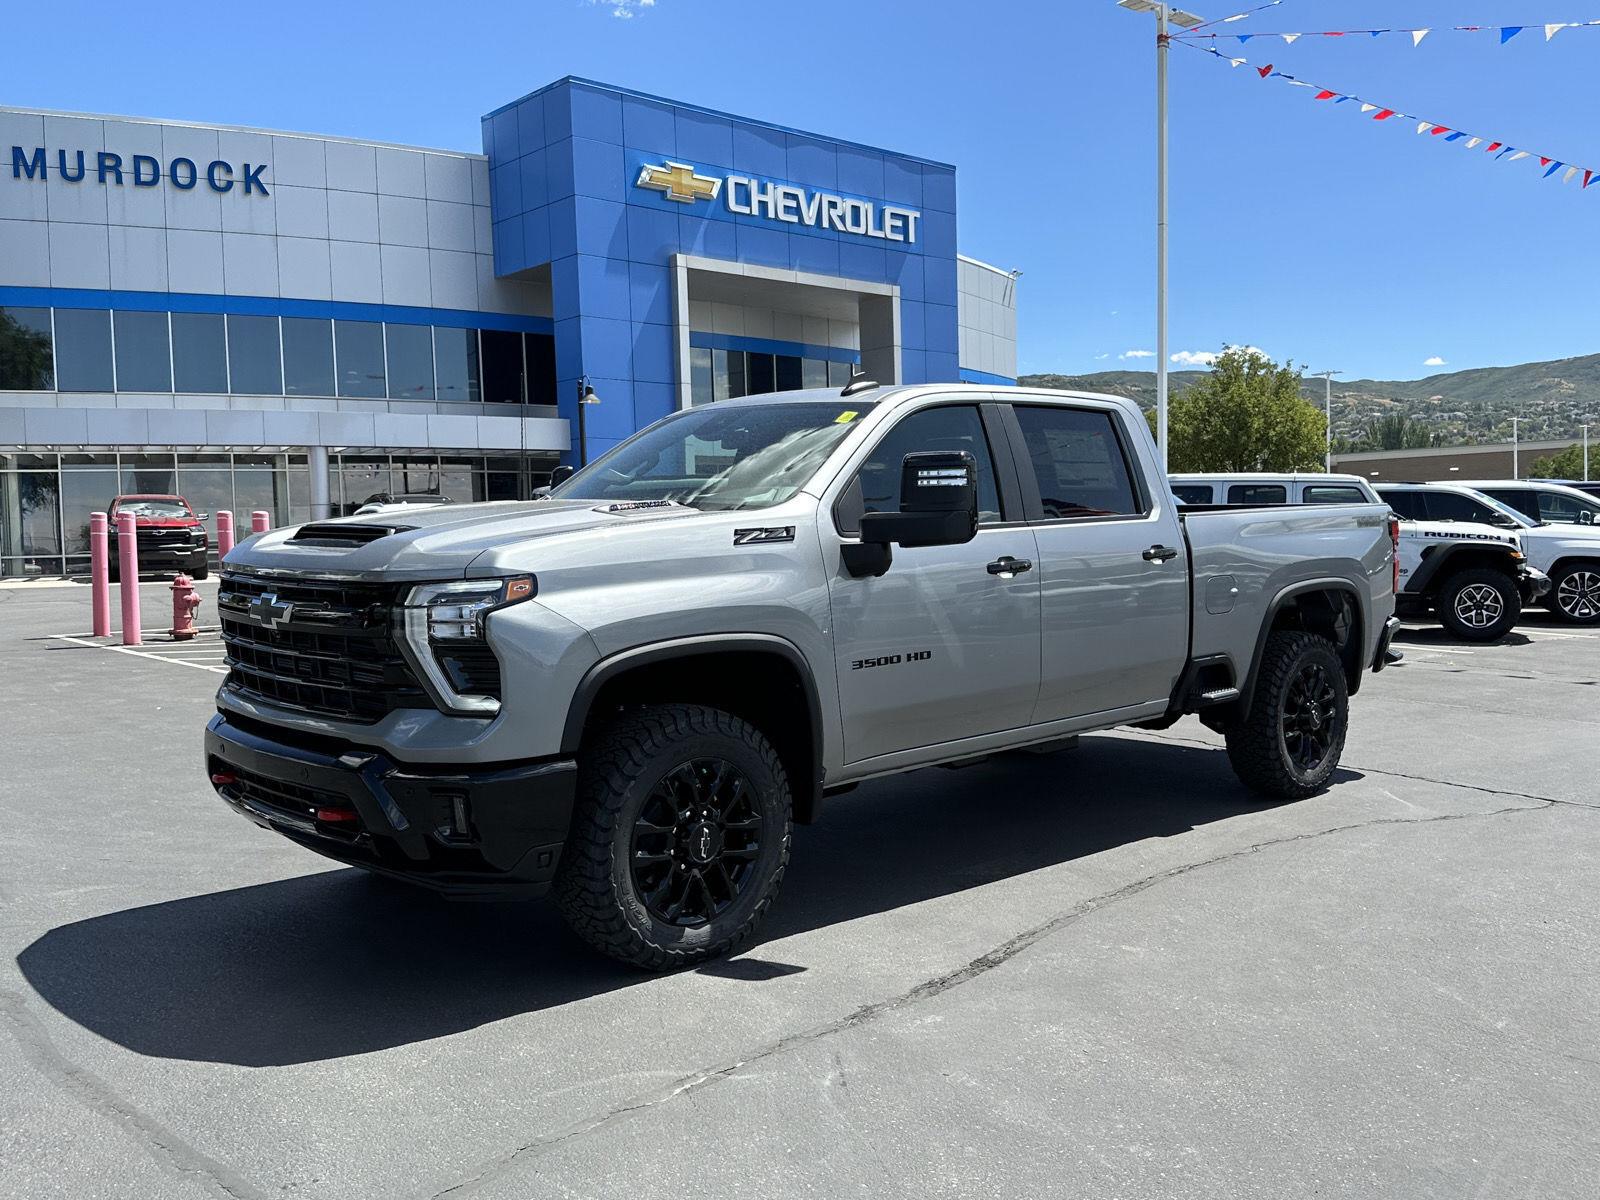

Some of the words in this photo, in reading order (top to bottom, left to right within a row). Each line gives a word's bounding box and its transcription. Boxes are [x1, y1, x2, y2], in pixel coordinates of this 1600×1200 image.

[11, 145, 270, 196] MURDOCK
[726, 175, 921, 243] CHEVROLET
[733, 526, 796, 546] Z71
[1424, 531, 1501, 541] RUBICON
[851, 655, 902, 670] 3500
[906, 650, 932, 662] HD
